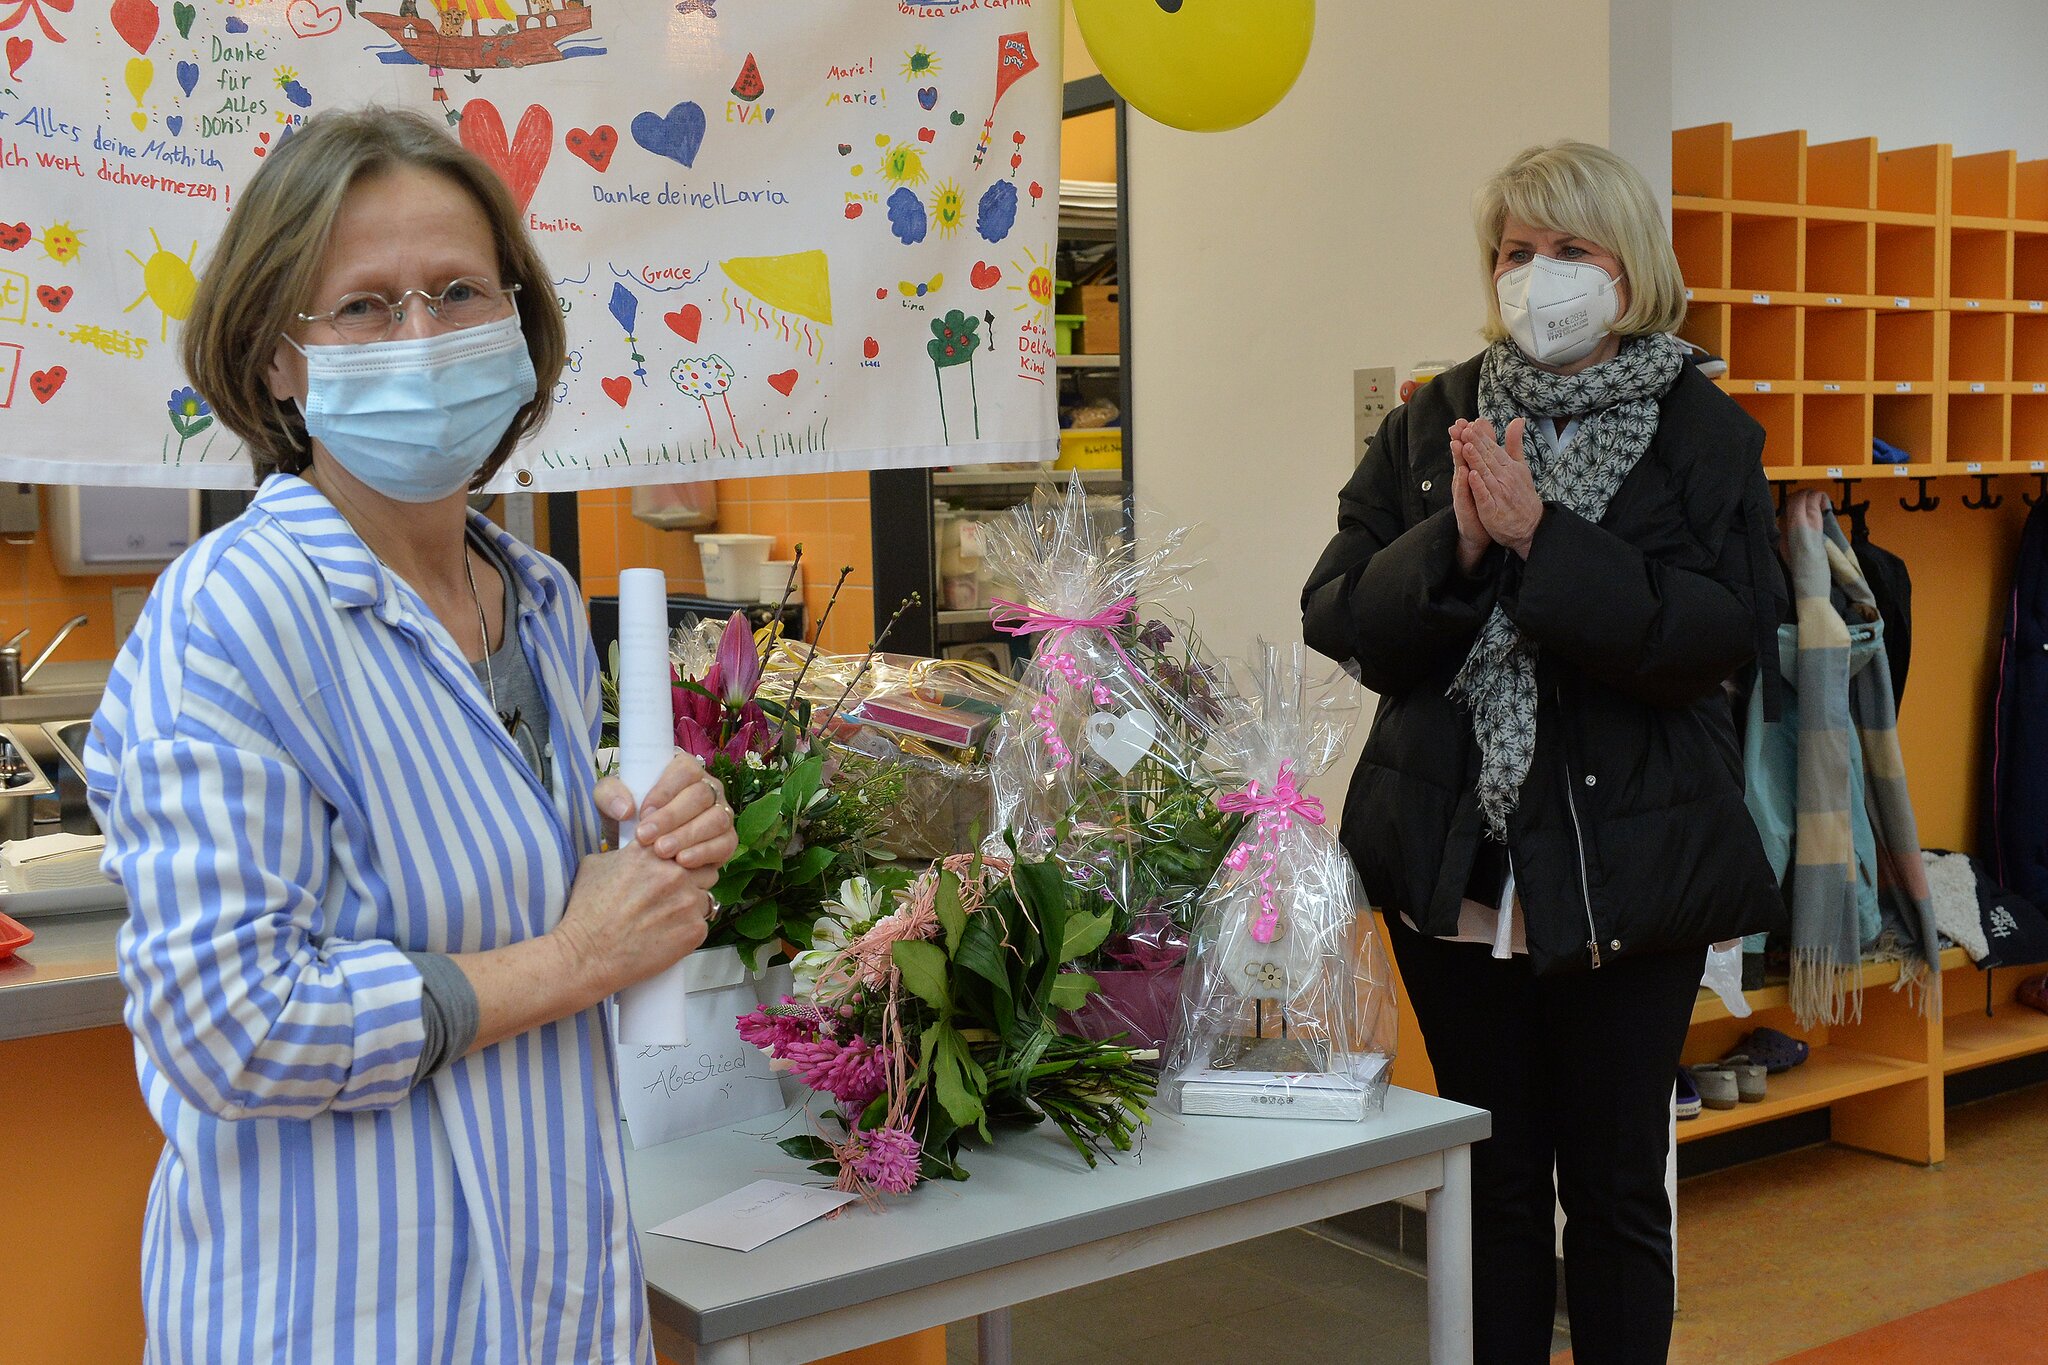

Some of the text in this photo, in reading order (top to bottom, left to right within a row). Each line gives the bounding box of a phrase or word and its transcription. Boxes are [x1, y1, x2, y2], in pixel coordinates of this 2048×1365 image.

[919, 7, 945, 18] Lea
[212, 35, 267, 62] Danke
[827, 57, 873, 80] Marie!
[217, 68, 252, 91] für
[825, 88, 887, 108] Marie!
[274, 110, 309, 127] ZARA
[726, 104, 763, 124] EVA
[93, 125, 136, 158] deine
[141, 139, 224, 172] Mathilda
[593, 184, 650, 205] Danke
[530, 213, 582, 233] Emilia
[643, 265, 691, 282] Grace
[1020, 355, 1046, 375] Kind
